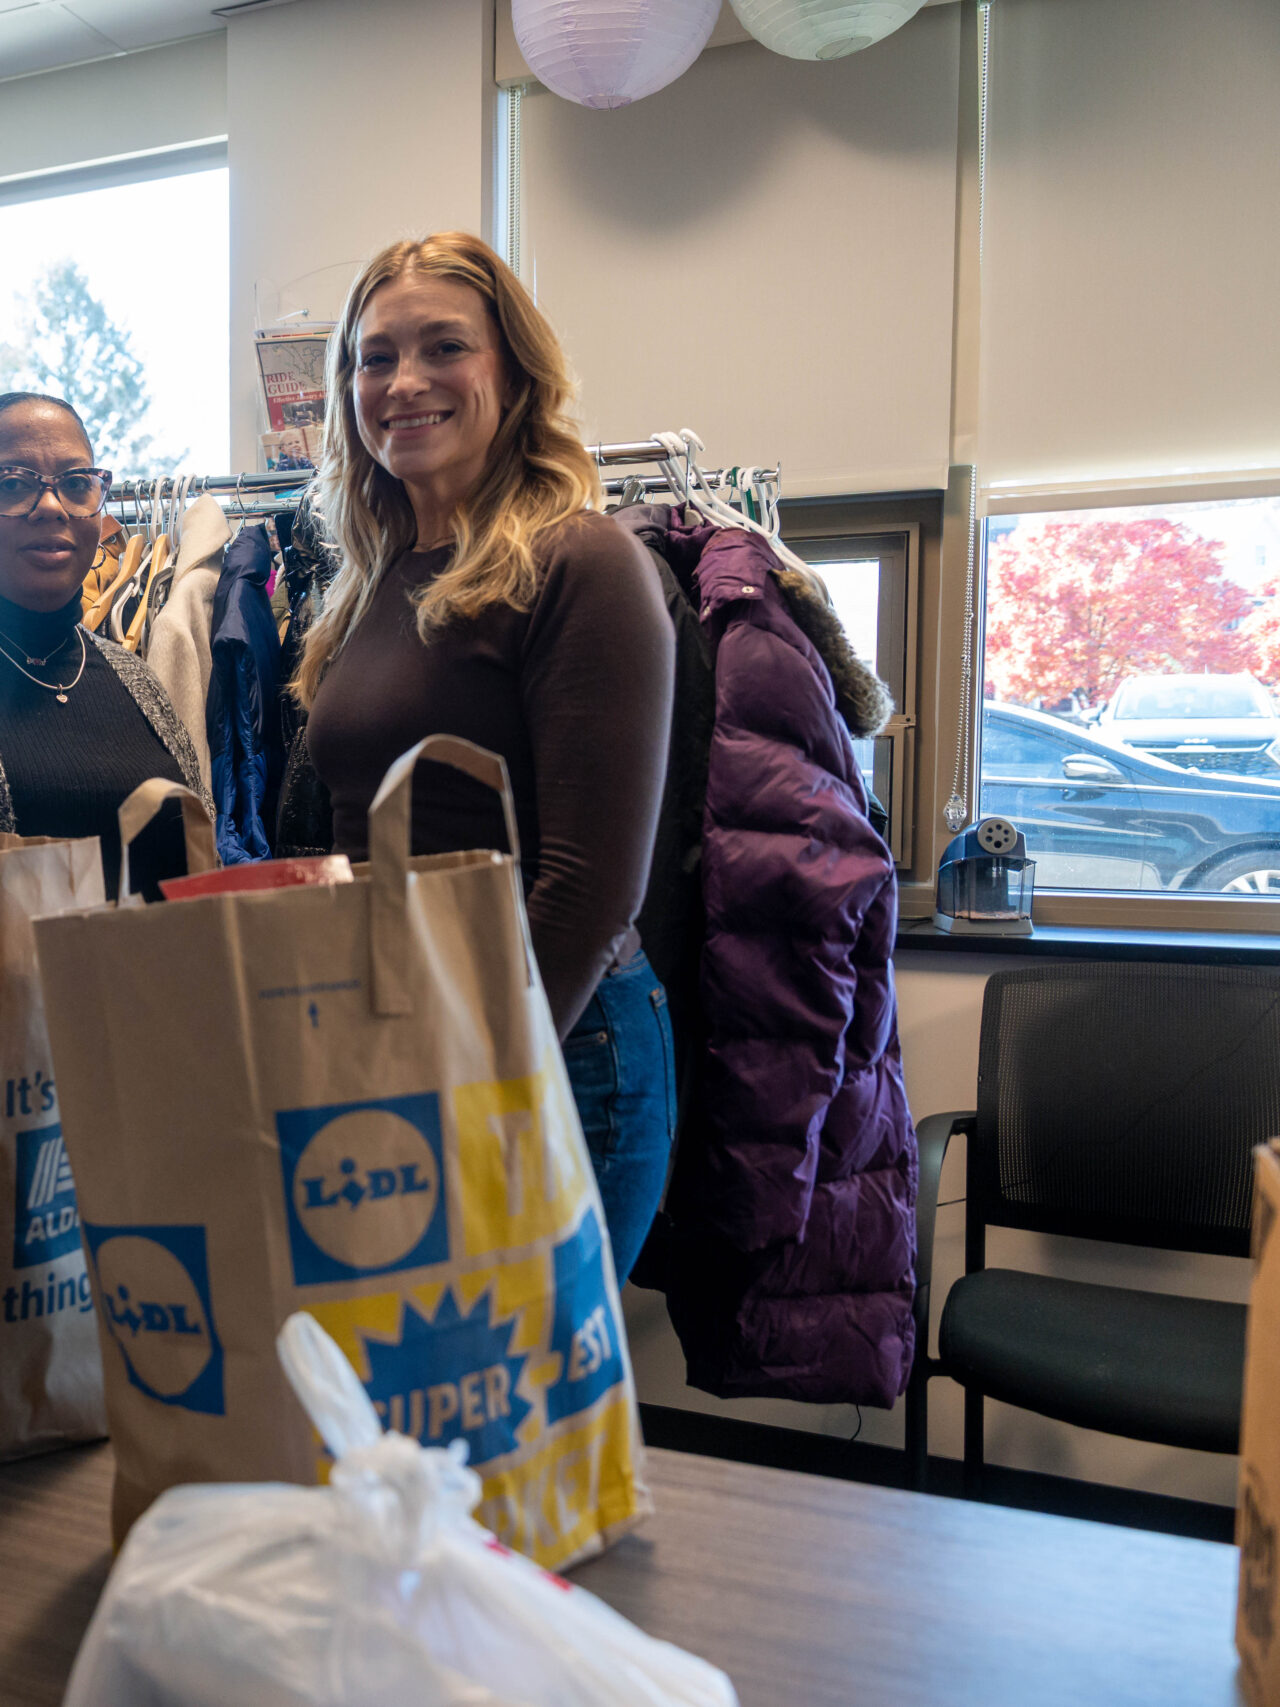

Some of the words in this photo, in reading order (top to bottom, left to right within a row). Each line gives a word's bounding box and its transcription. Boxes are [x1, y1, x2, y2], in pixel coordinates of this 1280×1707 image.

[266, 371, 295, 384] RIDE
[267, 381, 307, 395] GUIDE
[6, 1069, 56, 1118] It's
[373, 1362, 511, 1440] UPER
